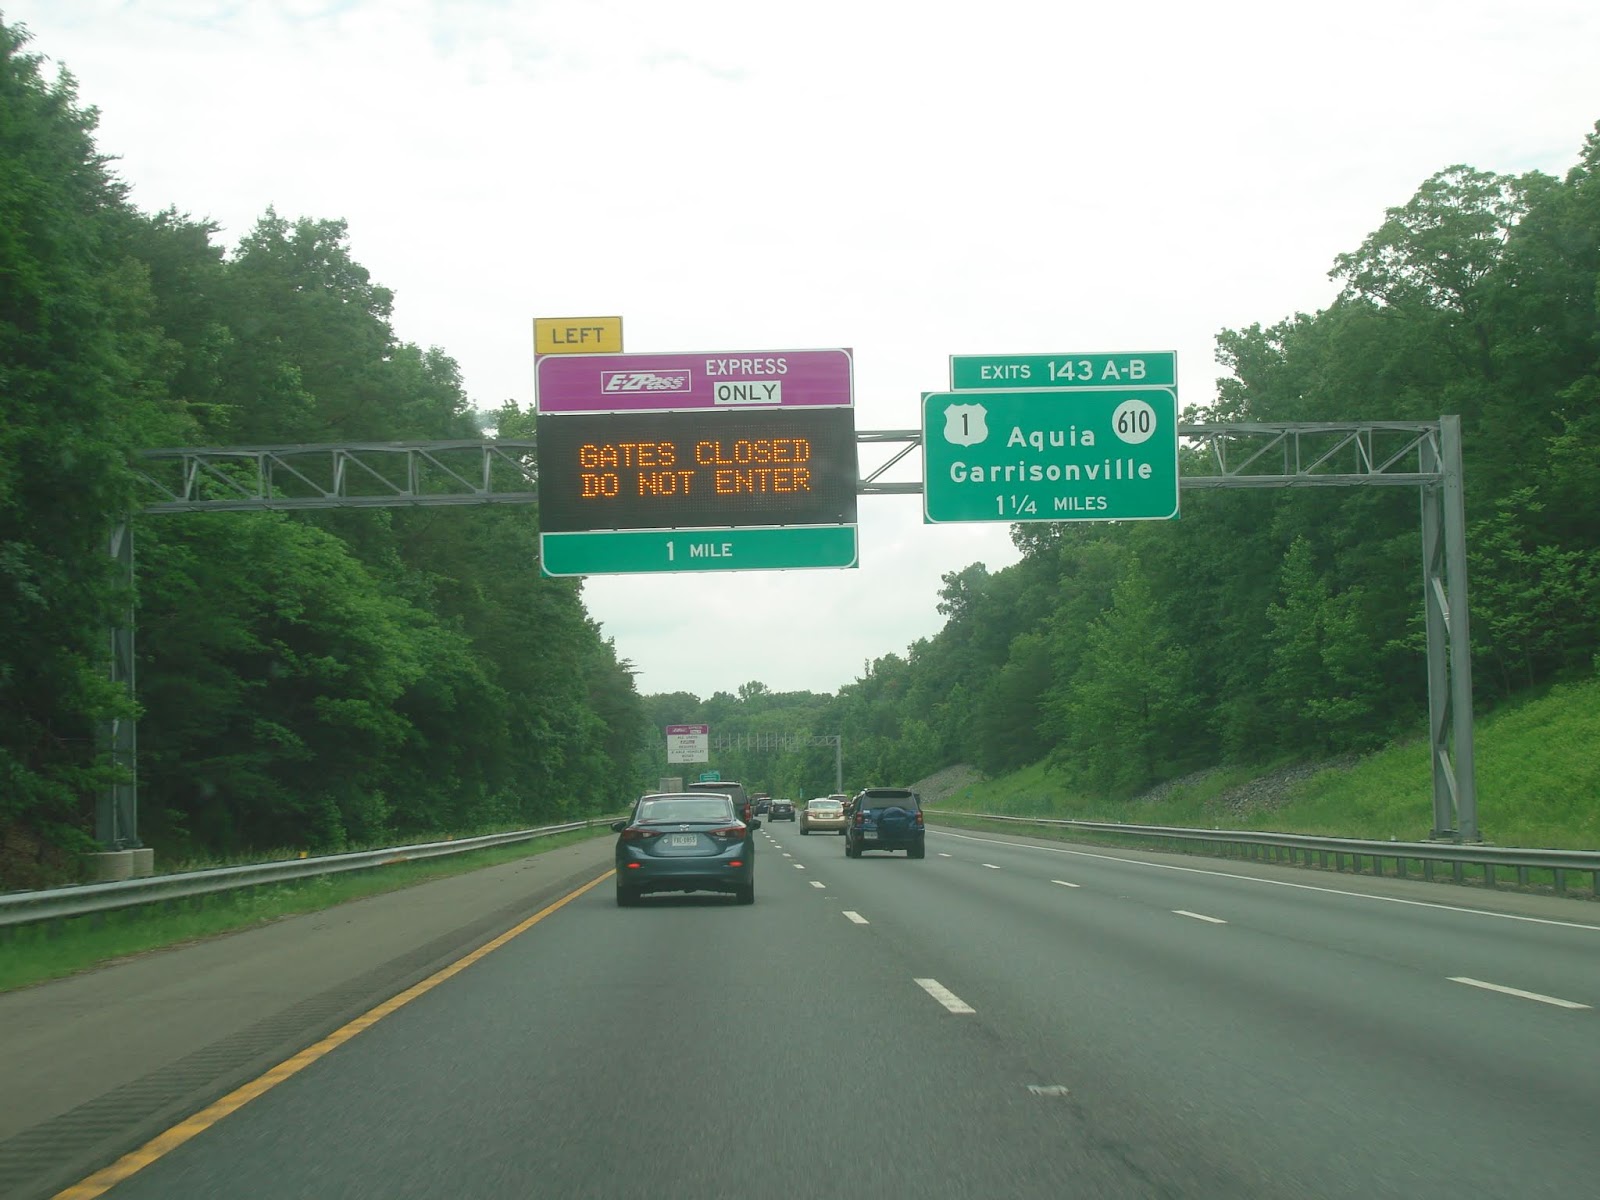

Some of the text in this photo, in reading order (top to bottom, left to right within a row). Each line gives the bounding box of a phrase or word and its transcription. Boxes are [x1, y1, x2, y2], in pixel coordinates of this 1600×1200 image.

[552, 327, 604, 344] LEFT
[706, 358, 788, 376] EXPRESS
[981, 359, 1146, 381] EXITS 143 A-B
[718, 384, 777, 401] ONLY
[961, 413, 969, 436] 1
[1117, 410, 1150, 434] 610
[1007, 425, 1096, 452] Aquia
[579, 439, 810, 468] GATES CLOSED
[950, 458, 1152, 483] Garrisonville
[581, 468, 811, 497] DO NOT ENTER
[1054, 496, 1108, 511] MILES
[666, 541, 733, 561] 1 MILE
